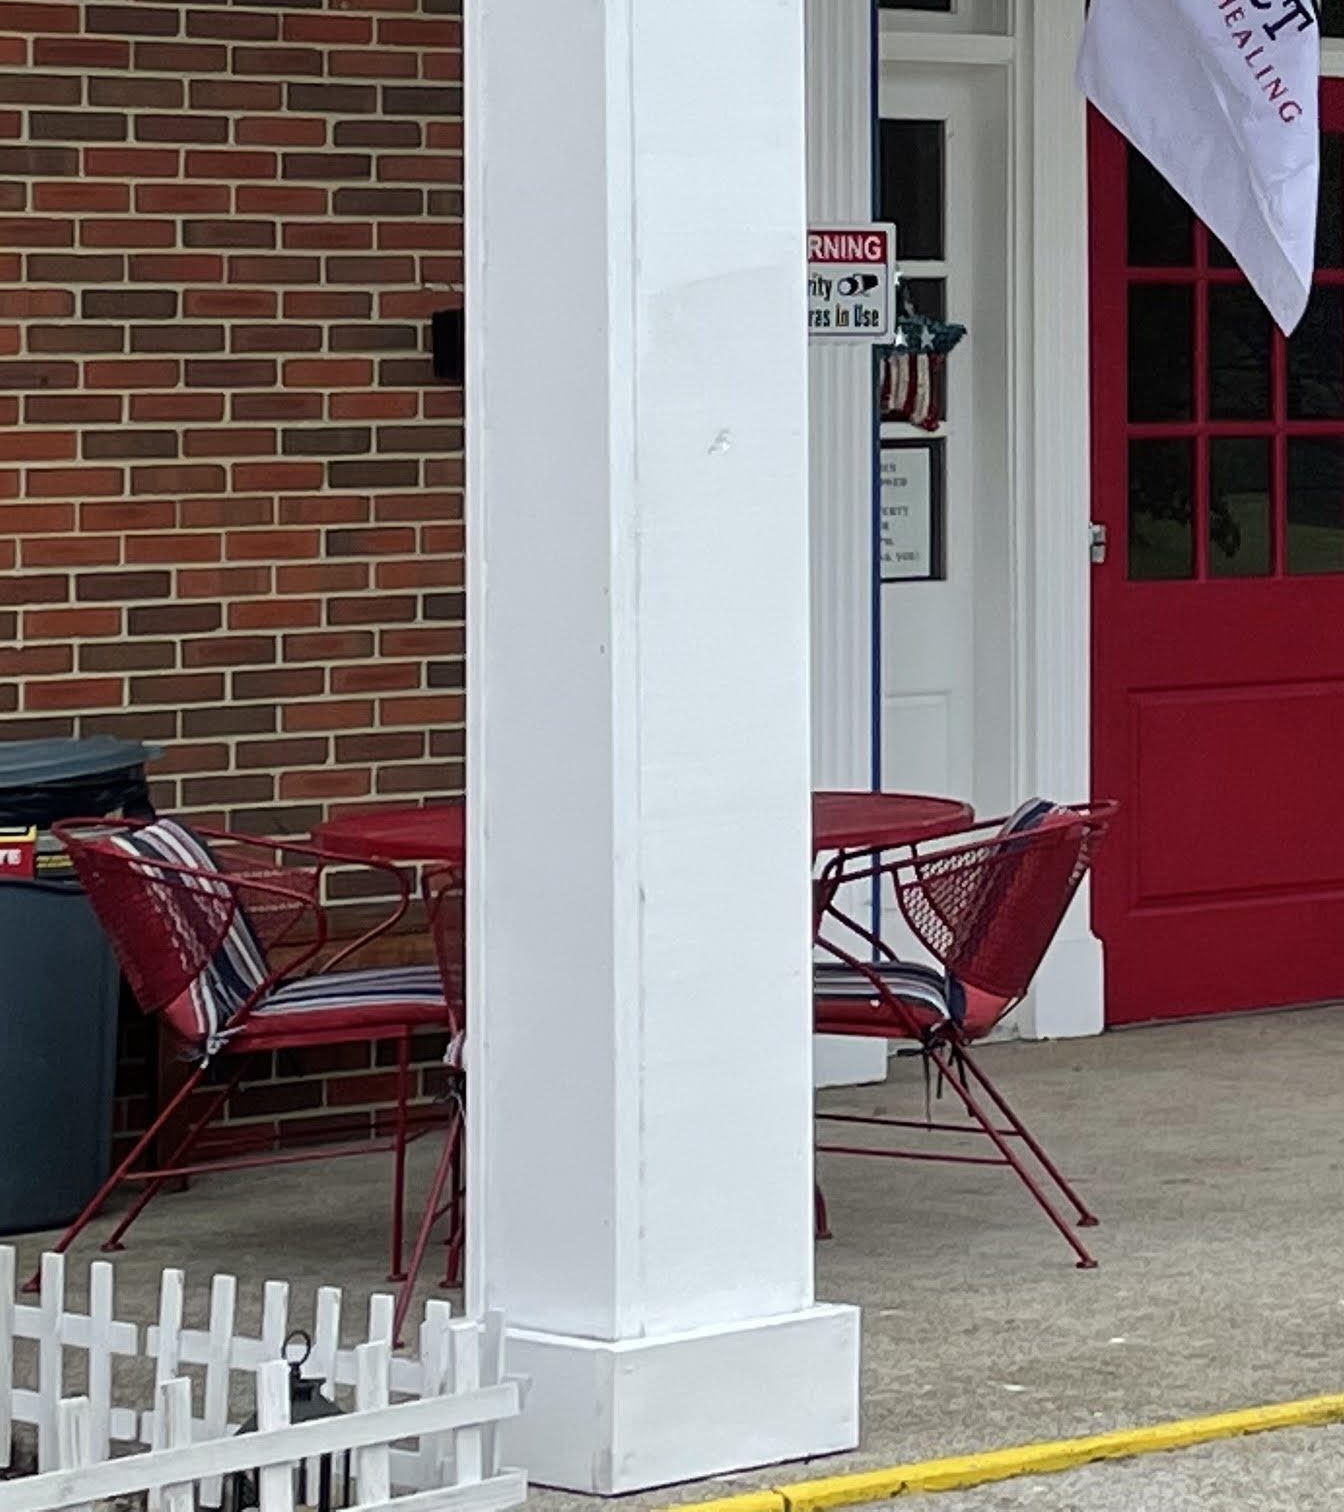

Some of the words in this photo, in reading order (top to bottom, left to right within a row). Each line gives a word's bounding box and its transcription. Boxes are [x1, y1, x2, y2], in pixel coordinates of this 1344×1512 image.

[806, 234, 882, 261] RNING
[807, 272, 833, 302] rity
[807, 308, 831, 328] ras
[855, 303, 880, 328] Use
